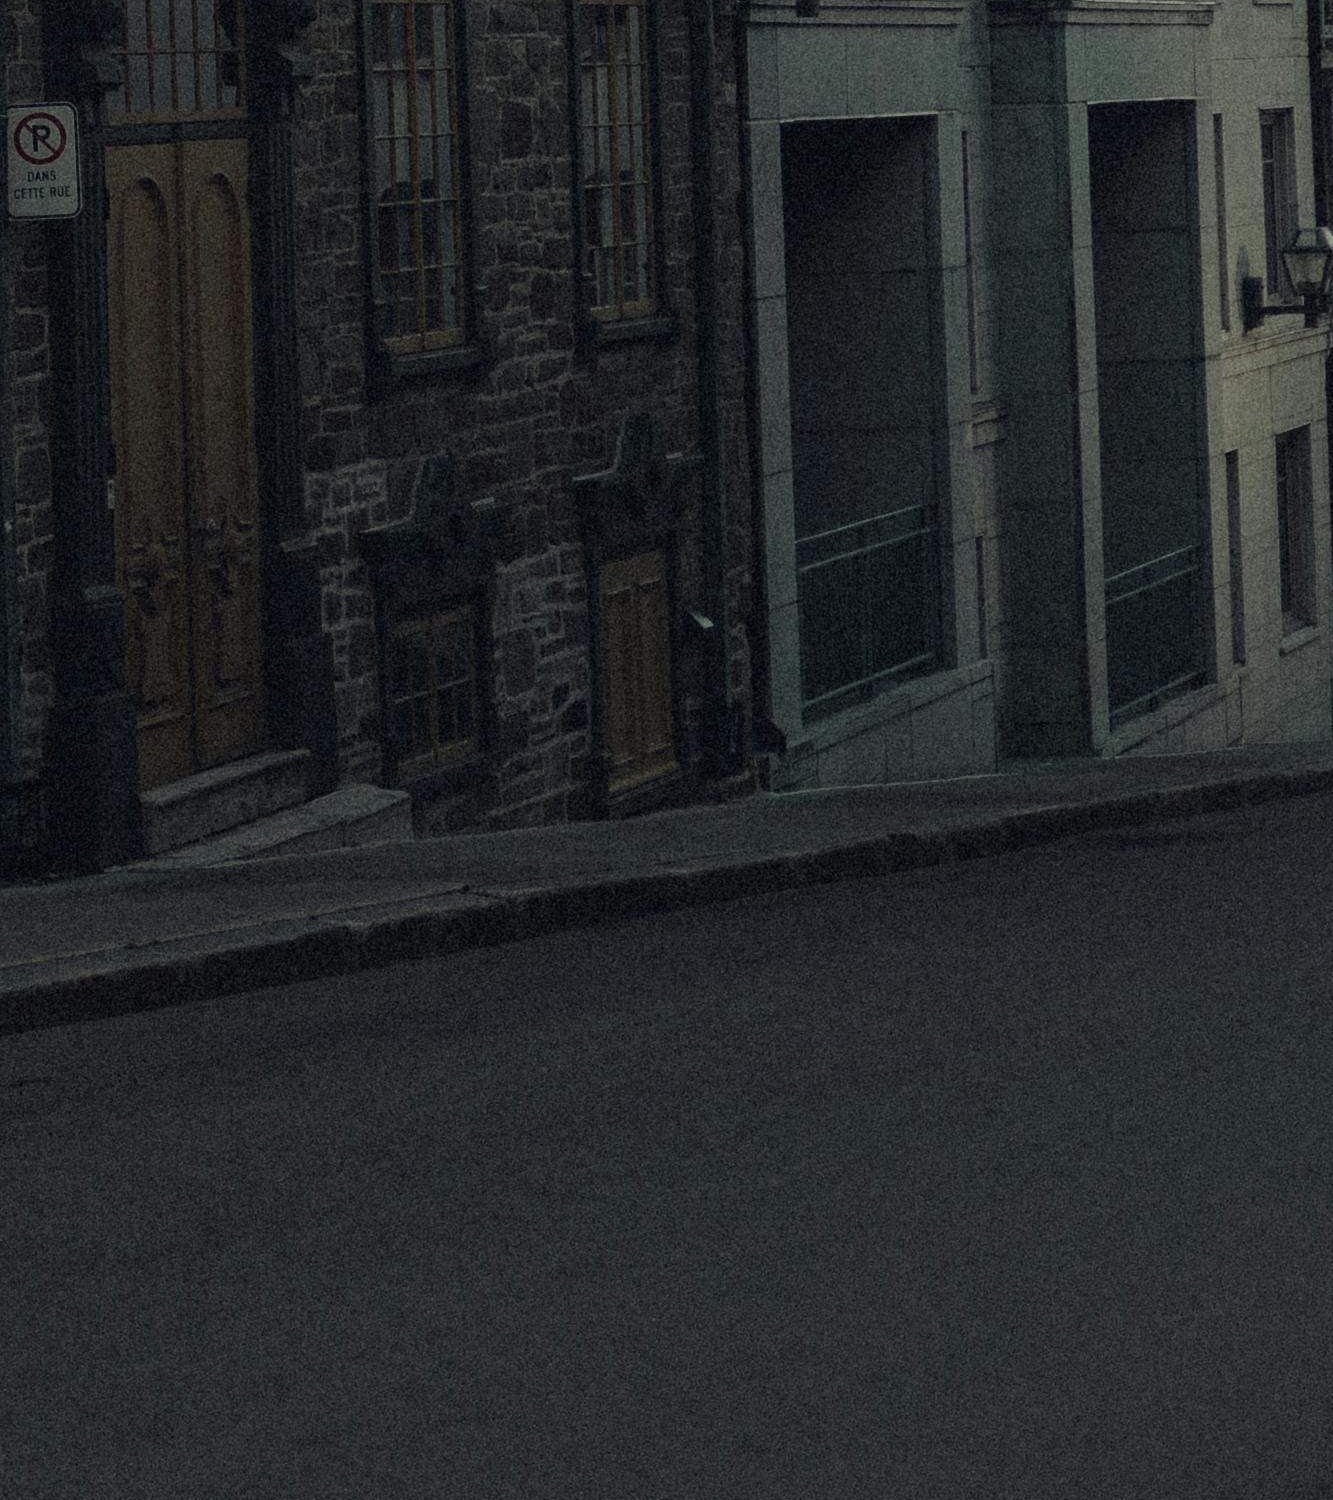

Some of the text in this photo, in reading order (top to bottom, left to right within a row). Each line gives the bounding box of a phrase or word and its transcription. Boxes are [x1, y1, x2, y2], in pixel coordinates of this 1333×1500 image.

[32, 125, 51, 152] P
[27, 170, 57, 182] DANS
[14, 185, 72, 200] CETTE RUE
